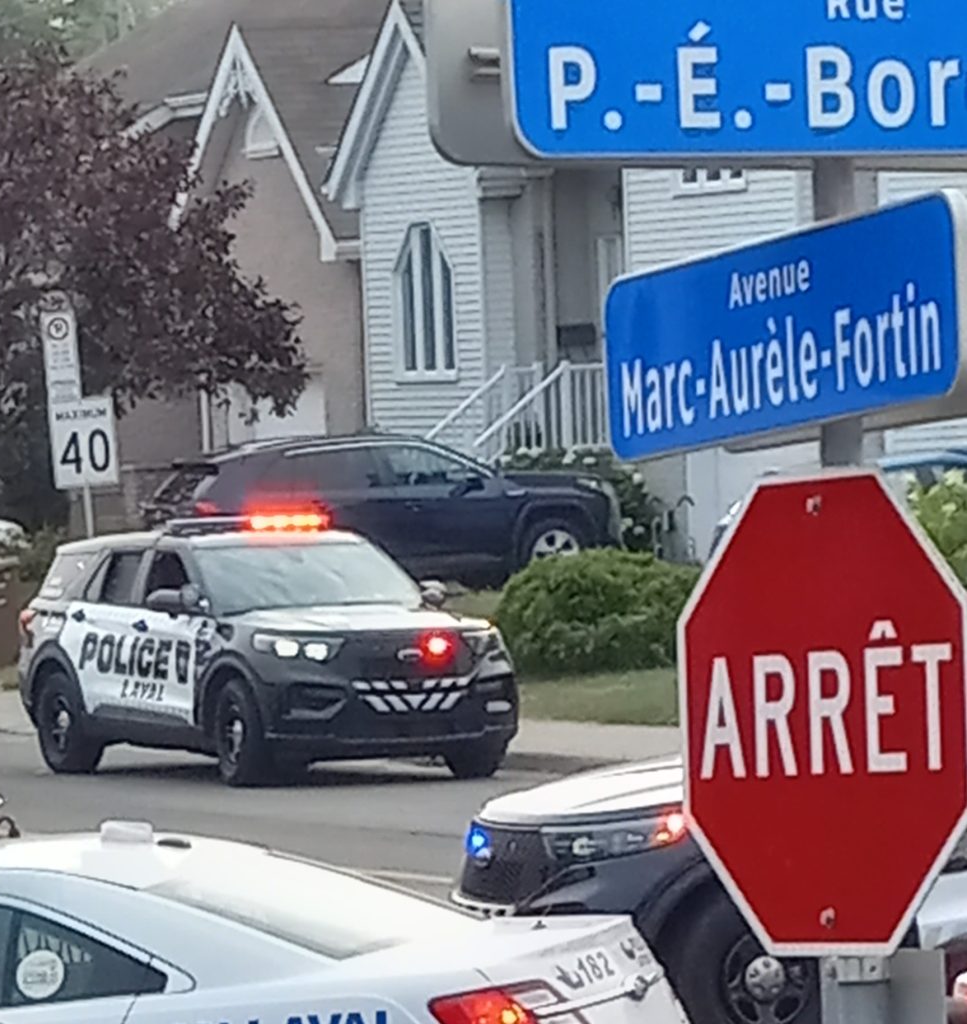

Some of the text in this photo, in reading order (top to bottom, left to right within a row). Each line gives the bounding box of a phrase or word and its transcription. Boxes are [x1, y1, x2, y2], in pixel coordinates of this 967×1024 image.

[729, 259, 810, 309] Avenue
[621, 283, 942, 437] Marc-Aurèle-Fortin
[55, 407, 107, 421] MAXIMUM
[60, 428, 110, 474] 40
[78, 632, 173, 680] POLICE
[700, 620, 952, 779] ARRÊT
[577, 951, 616, 984] 182
